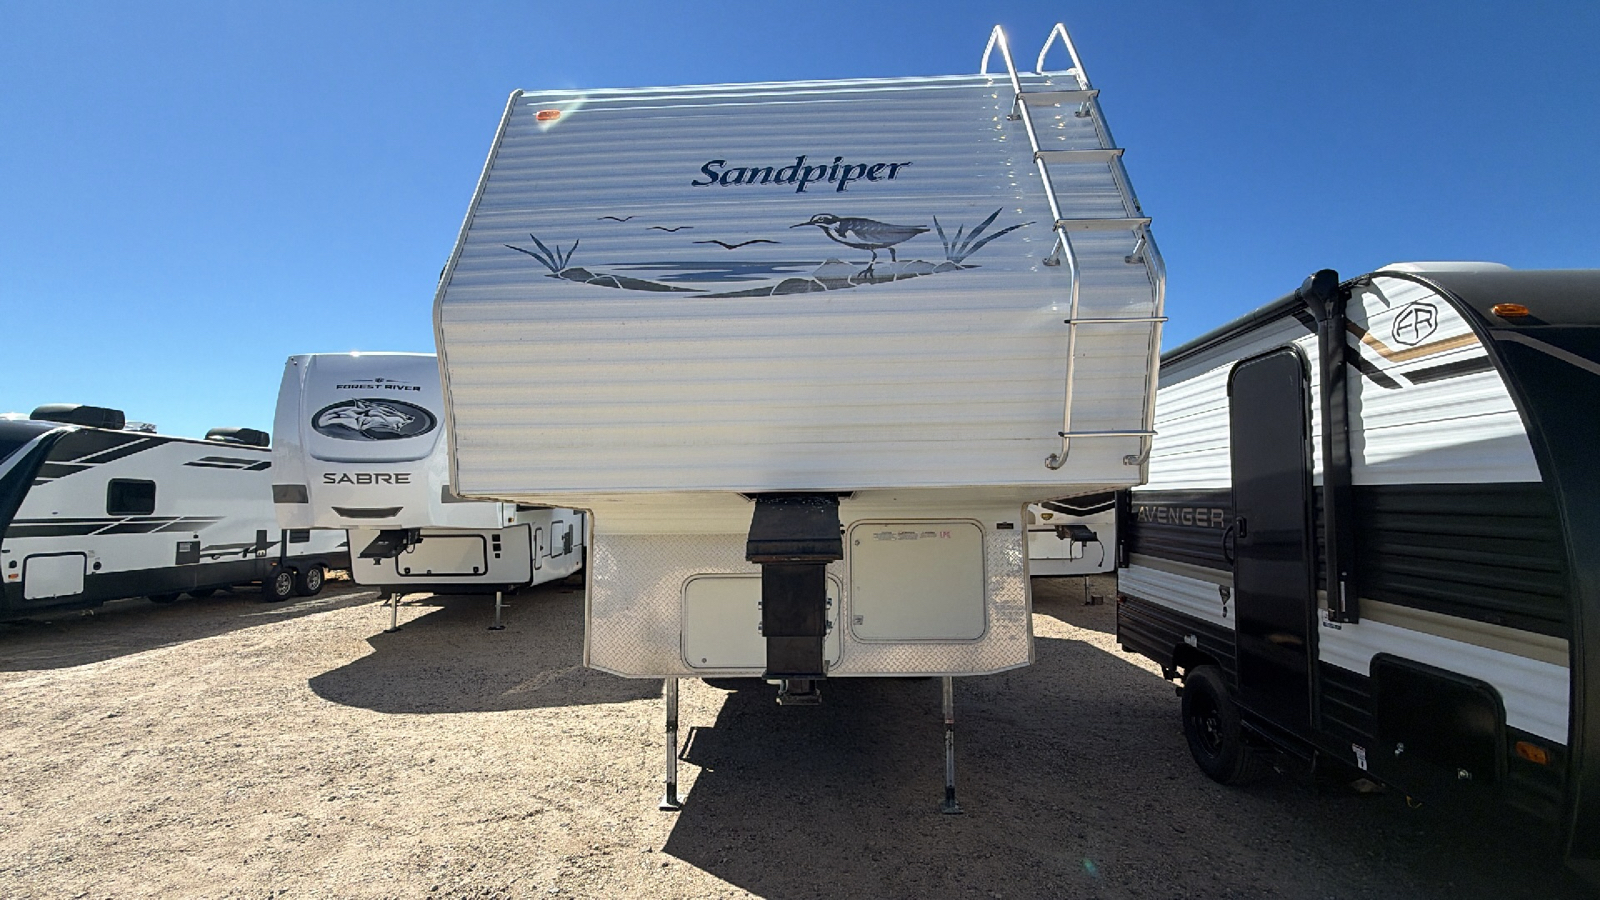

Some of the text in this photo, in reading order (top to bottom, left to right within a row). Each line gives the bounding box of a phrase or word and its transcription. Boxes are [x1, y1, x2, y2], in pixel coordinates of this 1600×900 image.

[691, 154, 913, 193] Sandpiper
[384, 384, 421, 392] RIVER
[323, 473, 412, 484] SABRE
[1137, 506, 1224, 528] AVENGER
